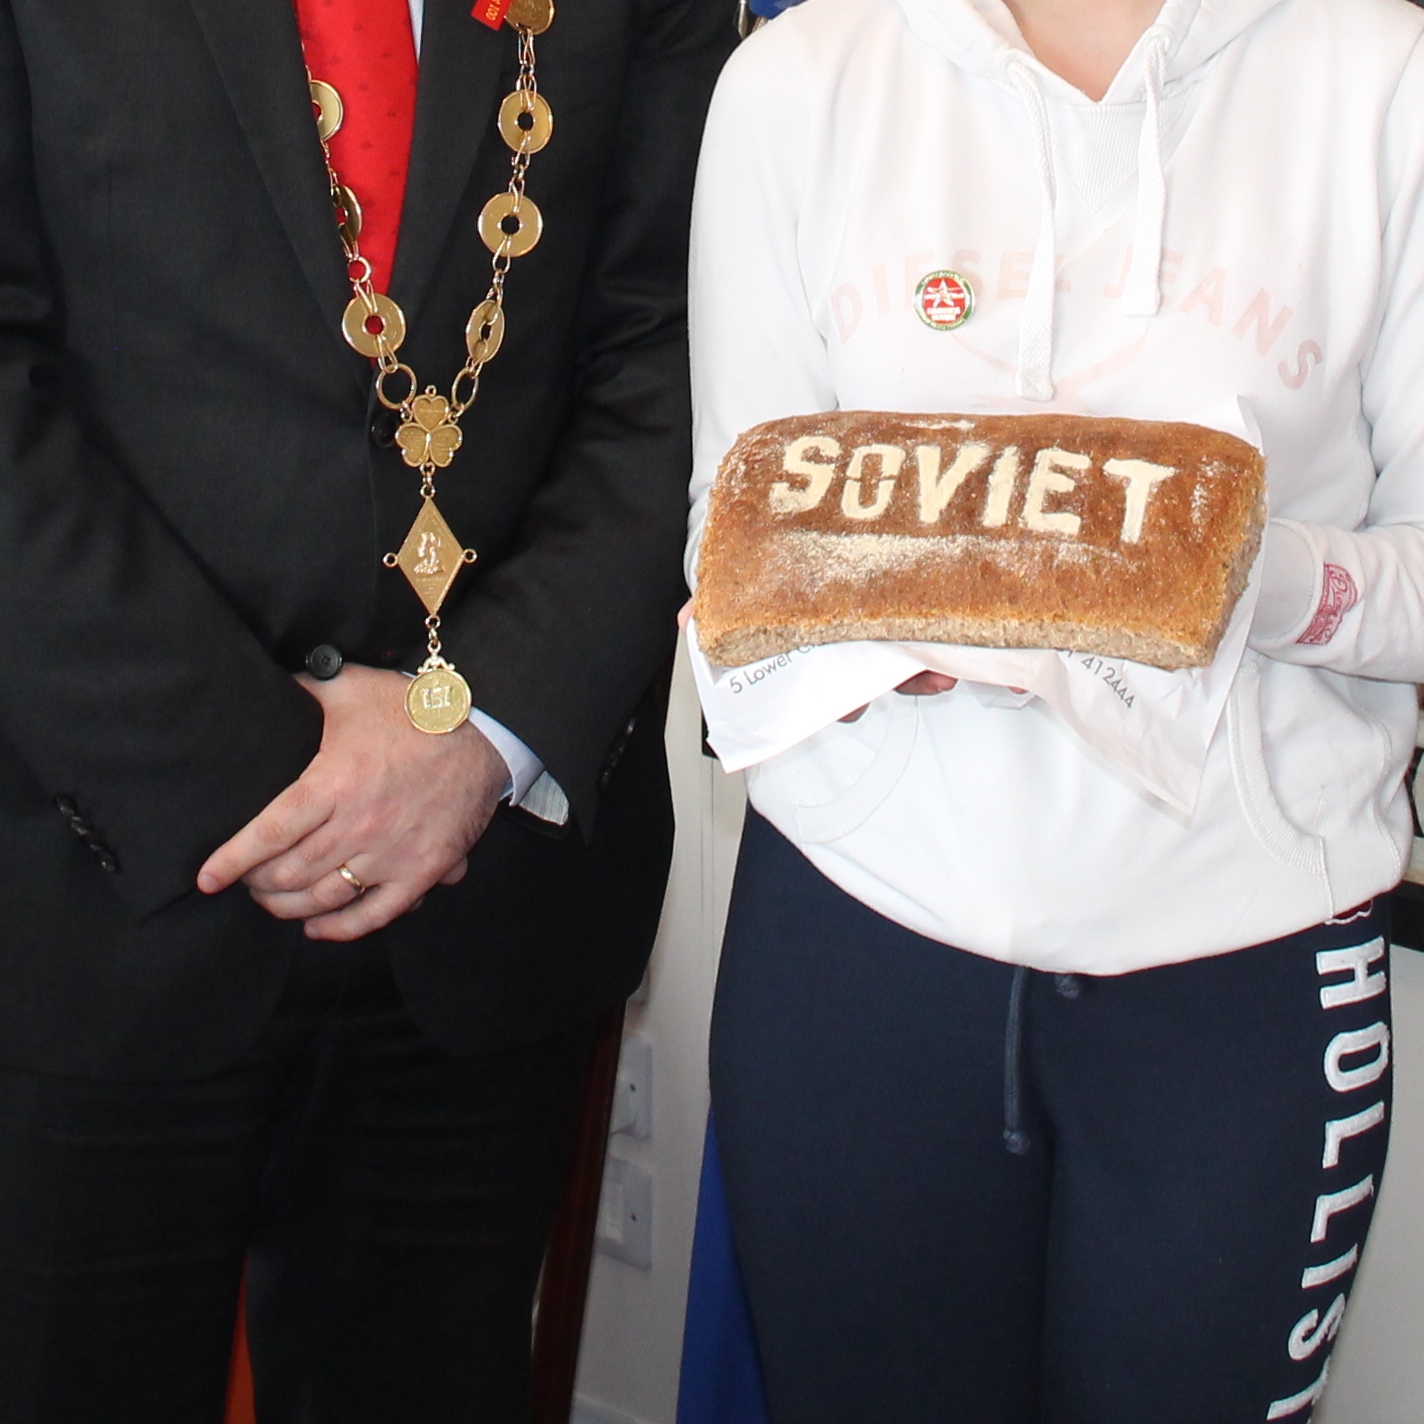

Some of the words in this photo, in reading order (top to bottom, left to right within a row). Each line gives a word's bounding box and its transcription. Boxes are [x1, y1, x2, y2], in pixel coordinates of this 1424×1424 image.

[769, 434, 1177, 544] SOVIET
[729, 676, 743, 694] 5
[743, 652, 793, 685] Lower
[1081, 656, 1136, 709] 412444
